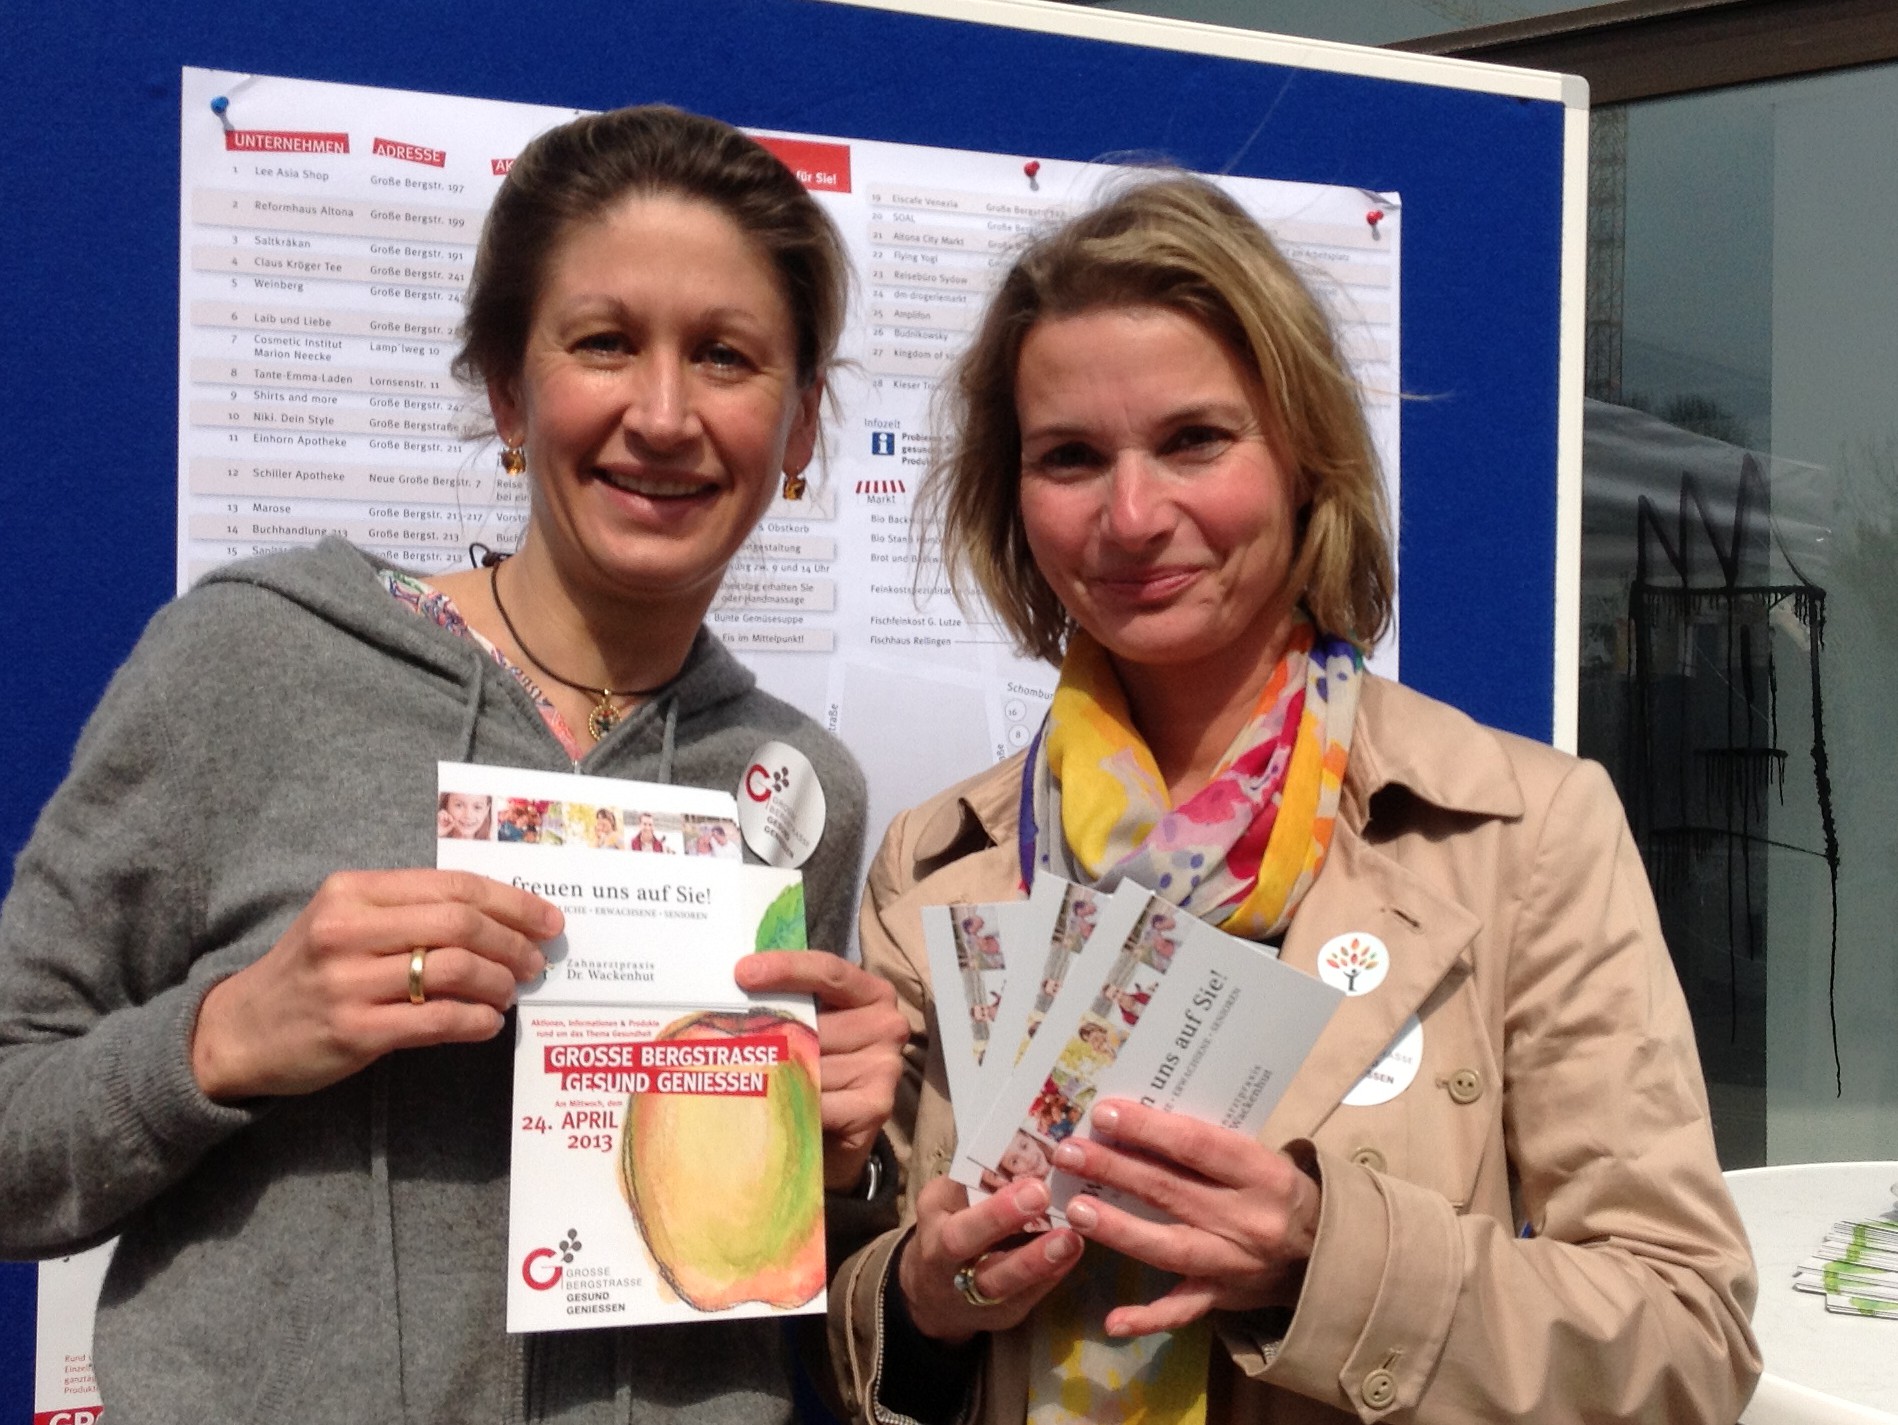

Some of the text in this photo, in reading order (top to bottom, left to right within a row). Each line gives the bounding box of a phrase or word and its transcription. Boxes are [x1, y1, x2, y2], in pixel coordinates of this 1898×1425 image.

[234, 132, 345, 154] UNTERNEHMEN
[375, 145, 441, 162] ADRESSE
[233, 166, 329, 181] 1 Lee Asia Shop
[816, 172, 837, 185] Sie!
[370, 176, 464, 193] Große Bergstr. 197
[233, 201, 354, 217] 2 Reformhaus Altona
[370, 210, 465, 227] Große Bergstr. 199
[232, 236, 238, 244] 3
[370, 244, 463, 261] Große Bergstr. 191
[232, 257, 342, 272] 4 Claus Kröger Tee
[370, 265, 464, 281] Große Bergstr. 241
[232, 278, 304, 292] 5 Weinberg
[370, 287, 444, 301] Große Bergstr.
[231, 312, 332, 327] 6 Laib und Liebe
[370, 320, 400, 331] Große
[404, 323, 444, 335] Bergstr.
[231, 334, 342, 349] 7 Cosmetic Institut
[254, 348, 332, 361] Marion Neecke
[231, 368, 353, 384] 8 Tante-Emma-Laden
[370, 376, 426, 388] Lornsenstr.
[231, 391, 338, 405] 9 Shirts and more
[369, 398, 443, 412] Große Bergstr.
[228, 412, 240, 420] 10
[281, 413, 304, 423] Dein
[308, 415, 334, 426] Style
[369, 418, 400, 429] Große
[864, 418, 901, 430] Infozeit
[228, 434, 347, 447] 11 Einhorn Apotheke
[369, 440, 400, 451] Große
[404, 442, 443, 454] Bergstr.
[228, 469, 345, 481] 12 Schiller Apotheke
[369, 474, 472, 488] Neue Große Bergstr.
[497, 479, 523, 488] Reise
[867, 495, 896, 504] Markt
[228, 503, 291, 513] 13 Marose
[369, 507, 443, 520] Große Bergstr.
[871, 514, 885, 523] Bio
[227, 524, 326, 536] 14 Buchhandlung
[768, 524, 809, 533] Obstkorb
[368, 529, 399, 539] Große
[443, 534, 459, 543] 213
[871, 534, 885, 543] Bio
[227, 547, 238, 556] 15
[403, 551, 442, 562] Bergstr.
[871, 553, 889, 562] Brot
[781, 564, 830, 573] und Uhr
[800, 584, 814, 592] Sie
[714, 614, 804, 624] Bunte Gemüsesuppe
[870, 617, 925, 627] Fischfeinkost
[738, 635, 749, 643] im
[870, 636, 911, 645] Fischhaus
[592, 884, 630, 900] uns
[637, 884, 672, 902] auf
[676, 885, 712, 905] Sie!
[595, 907, 708, 920] ERWACHSENE SENIOREN
[566, 958, 655, 971] Zahnarztpraxis
[588, 969, 655, 981] Wackenhut
[568, 1019, 618, 1027] Informationen
[629, 1019, 660, 1027] Produkte
[1150, 968, 1230, 1091] uns auf Sie!
[612, 1030, 652, 1038] Gesundheit
[550, 1045, 779, 1068] GROSSE BERGSTRASSE
[566, 1072, 764, 1093] GESUND GENIESSEN
[522, 1111, 619, 1134] 24. APRIL
[568, 1134, 613, 1151] 2013
[566, 1267, 611, 1278] GROSSE
[566, 1278, 643, 1290] BERGSTRASSE
[566, 1292, 610, 1302] GESUND
[566, 1303, 626, 1315] GENIESSEN
